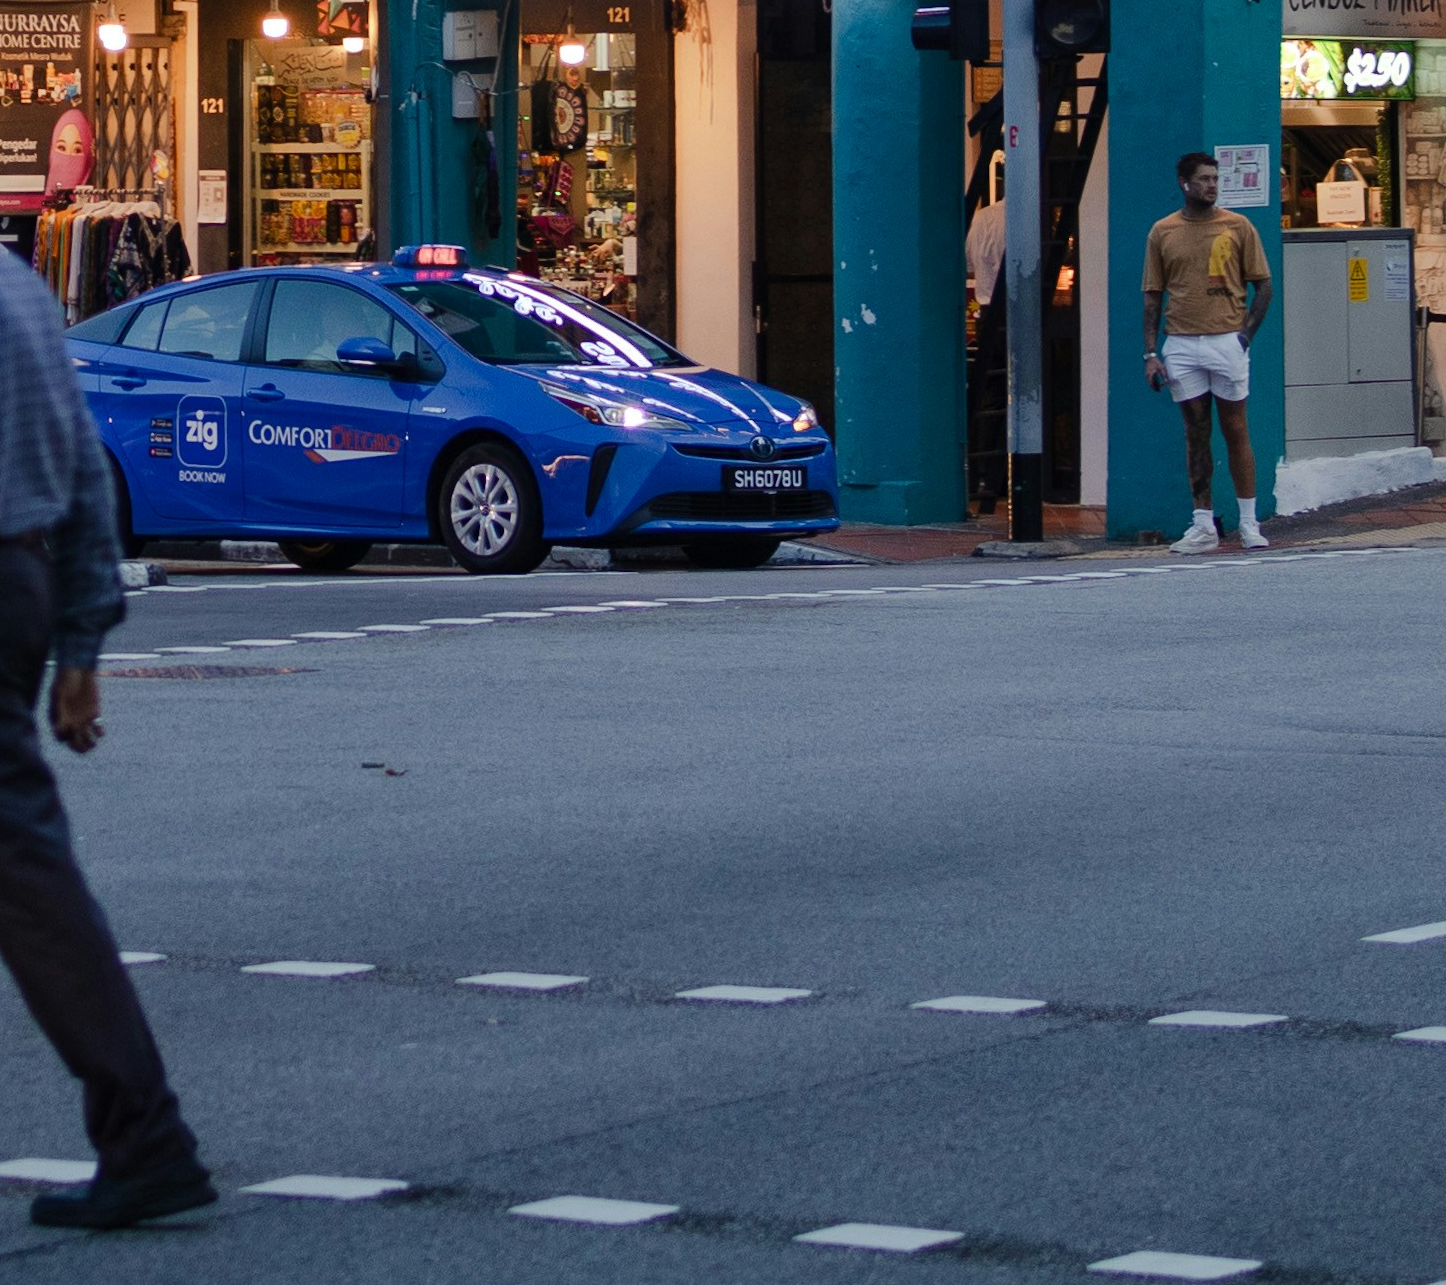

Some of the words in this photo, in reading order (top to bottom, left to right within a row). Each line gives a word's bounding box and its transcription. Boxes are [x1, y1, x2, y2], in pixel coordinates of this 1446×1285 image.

[607, 7, 630, 23] 121
[31, 33, 81, 49] CENTRE
[201, 98, 224, 114] 121
[186, 410, 218, 450] zig
[179, 470, 203, 482] BOOK
[204, 471, 226, 483] NOW
[734, 470, 802, 488] SH6078U
